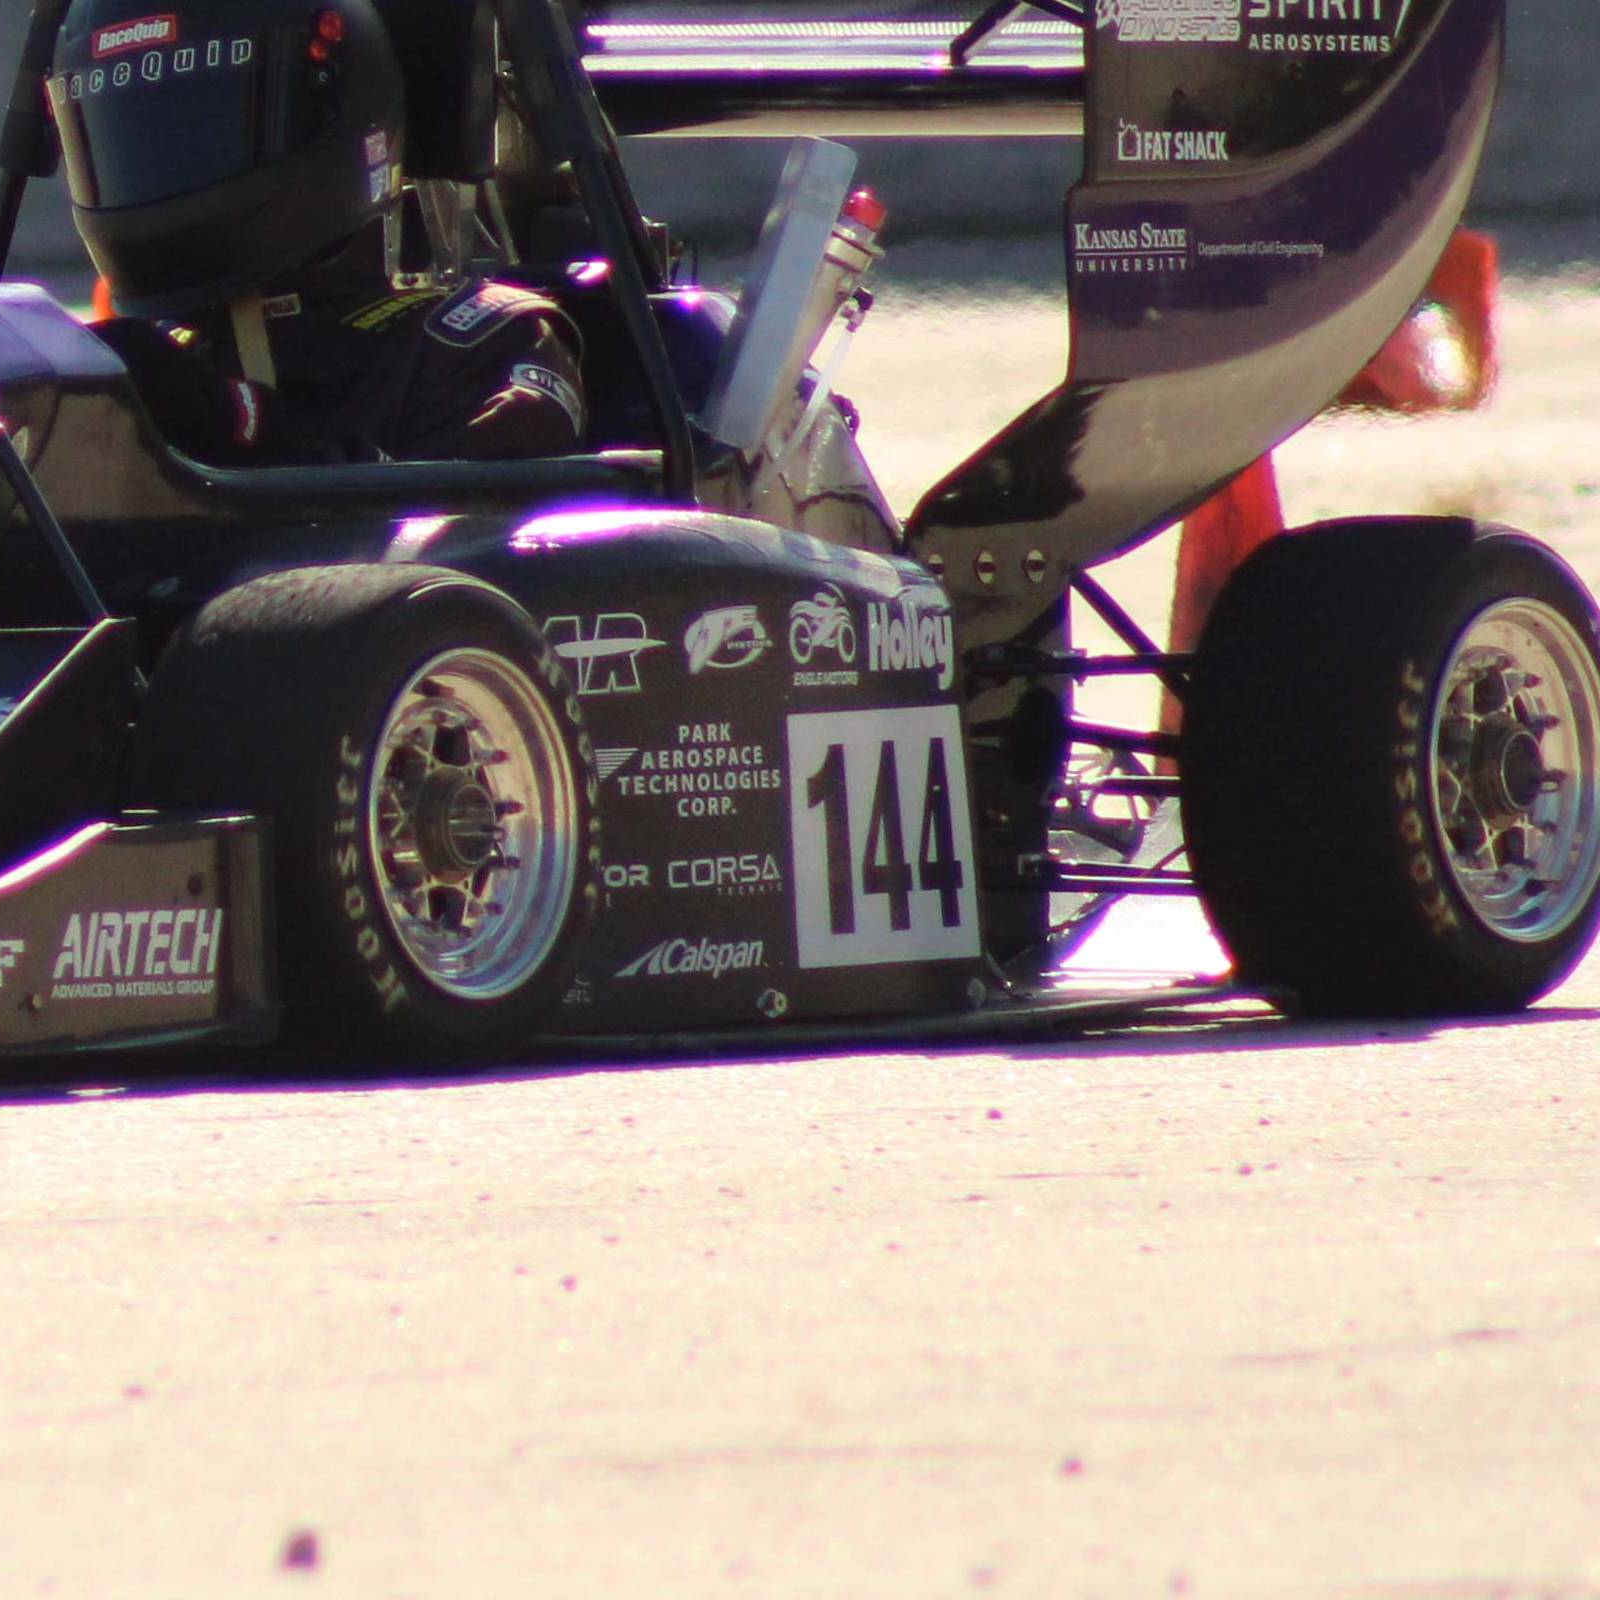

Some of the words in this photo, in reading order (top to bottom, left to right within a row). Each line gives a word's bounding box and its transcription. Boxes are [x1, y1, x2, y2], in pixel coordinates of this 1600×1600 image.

[99, 20, 170, 51] RaceQuip
[1250, 34, 1391, 51] AEROSYSTEMS
[1144, 132, 1172, 161] FAT
[1174, 131, 1229, 161] SHACK
[1076, 257, 1187, 273] UNIVERSITY
[867, 600, 954, 690] Holley
[679, 723, 731, 743] PARK
[641, 745, 763, 770] AEROSPACE
[618, 769, 782, 796] TECHNOLOGIES
[678, 797, 737, 818] CORP.
[805, 737, 964, 936] 144
[602, 864, 649, 888] OR
[668, 854, 781, 888] CORSA
[52, 908, 224, 980] AIRTECH
[662, 937, 764, 979] Calspan
[51, 980, 112, 999] ADVANCED
[114, 980, 175, 998] MATERIALS
[176, 979, 216, 997] GROUP
